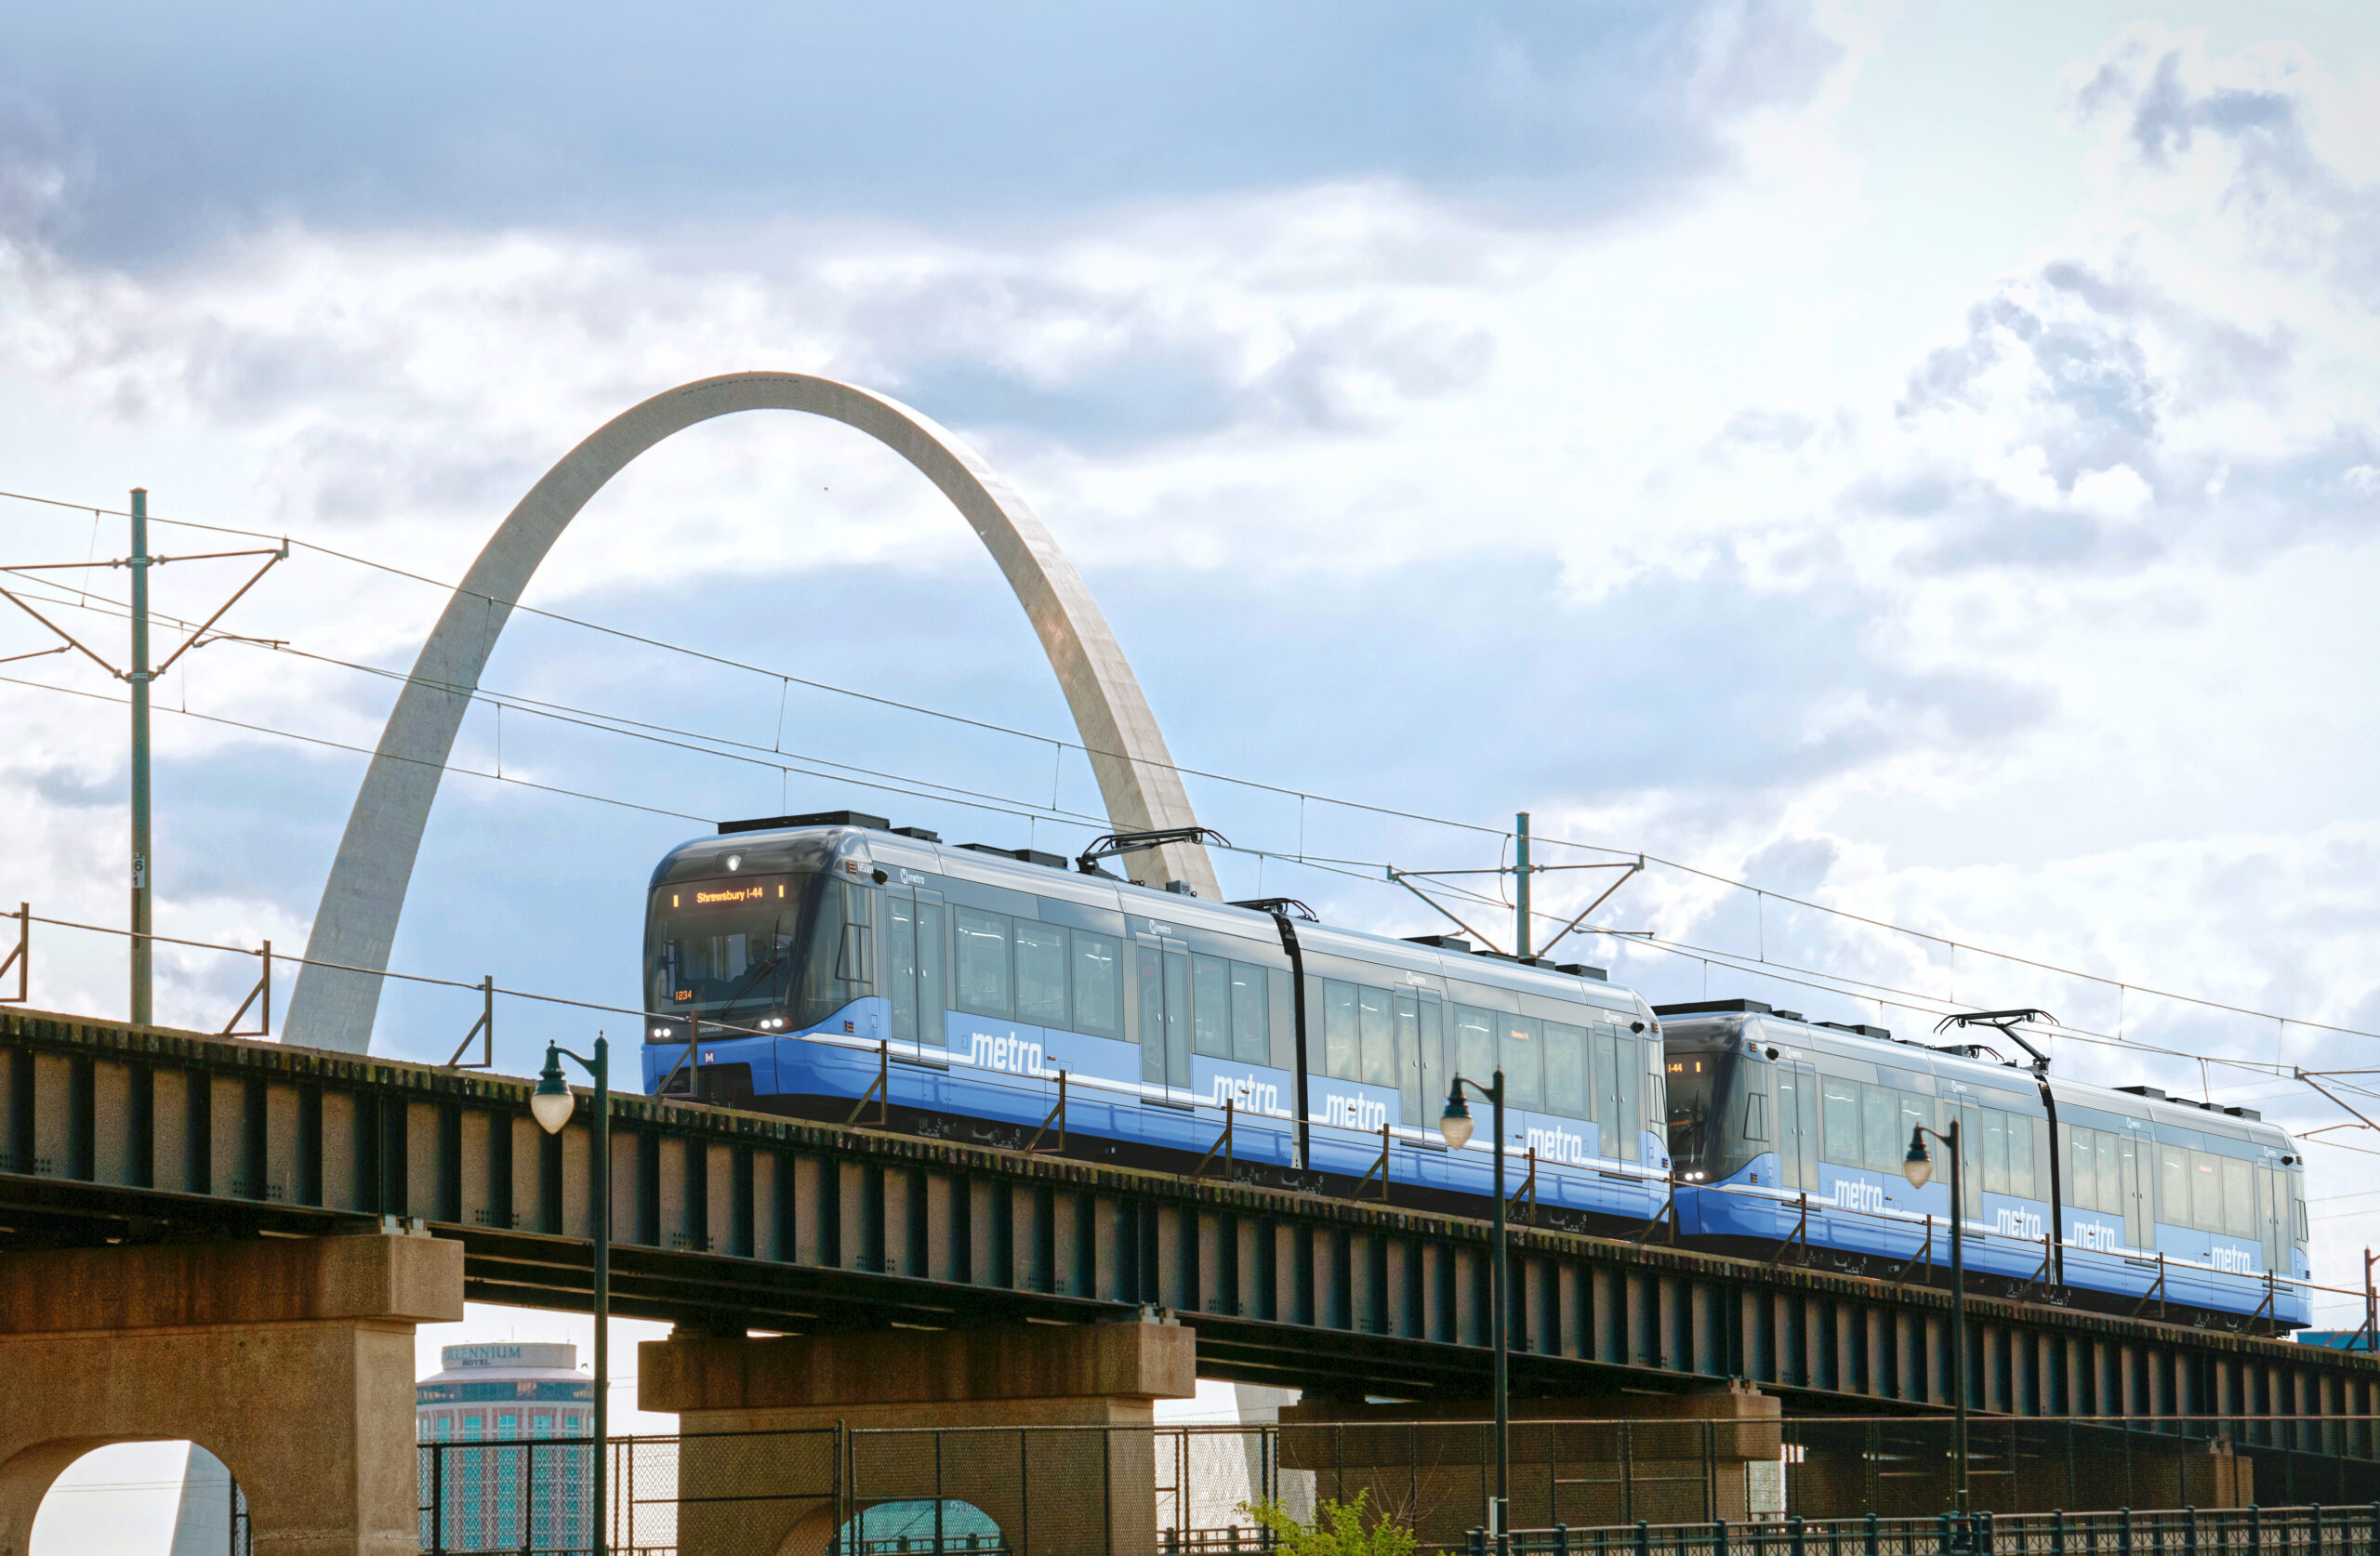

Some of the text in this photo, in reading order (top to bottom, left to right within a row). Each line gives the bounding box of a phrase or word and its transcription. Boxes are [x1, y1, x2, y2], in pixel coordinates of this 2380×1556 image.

[696, 887, 763, 903] Shrewsbury I-44
[908, 874, 925, 885] metro
[675, 990, 693, 1002] 1234
[705, 1052, 714, 1062] M
[970, 1031, 1042, 1075] metro
[1212, 1073, 1277, 1115] metro
[1325, 1091, 1386, 1132] metro
[1526, 1125, 1582, 1164] metro
[1834, 1177, 1883, 1213] metro
[1997, 1206, 2041, 1241] metro
[2073, 1220, 2115, 1253] metro
[2212, 1245, 2251, 1275] metro
